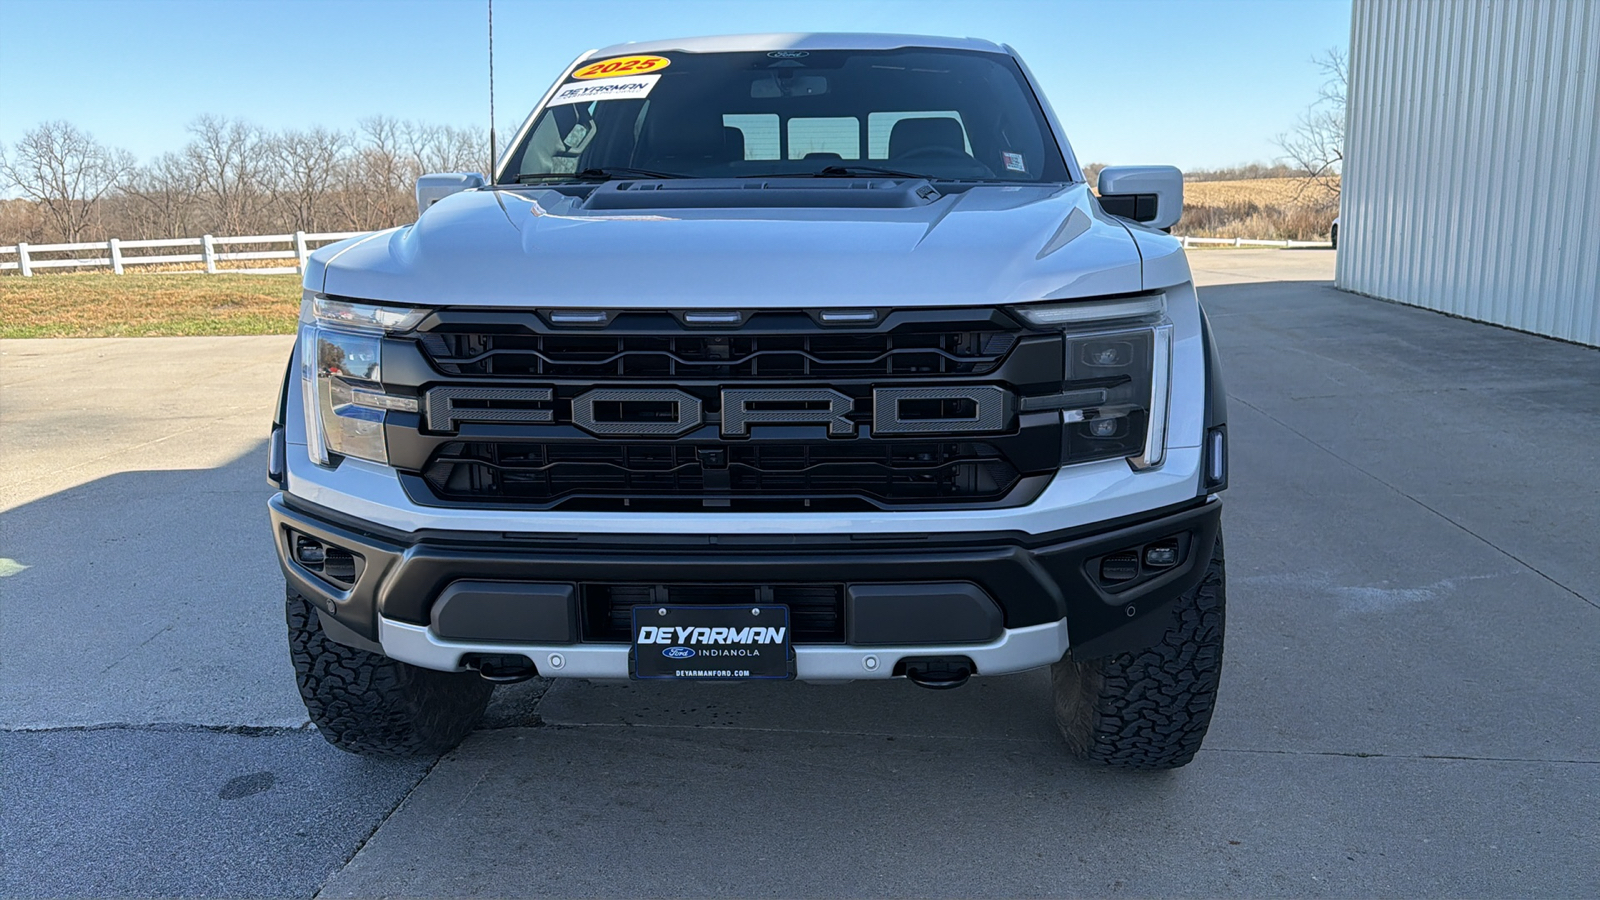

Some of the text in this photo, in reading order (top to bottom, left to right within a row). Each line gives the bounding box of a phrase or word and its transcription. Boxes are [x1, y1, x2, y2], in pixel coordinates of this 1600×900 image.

[579, 58, 662, 76] 2025
[560, 82, 649, 97] DEYARMAN
[425, 385, 1004, 435] FORD
[637, 626, 786, 645] DEYARMAN
